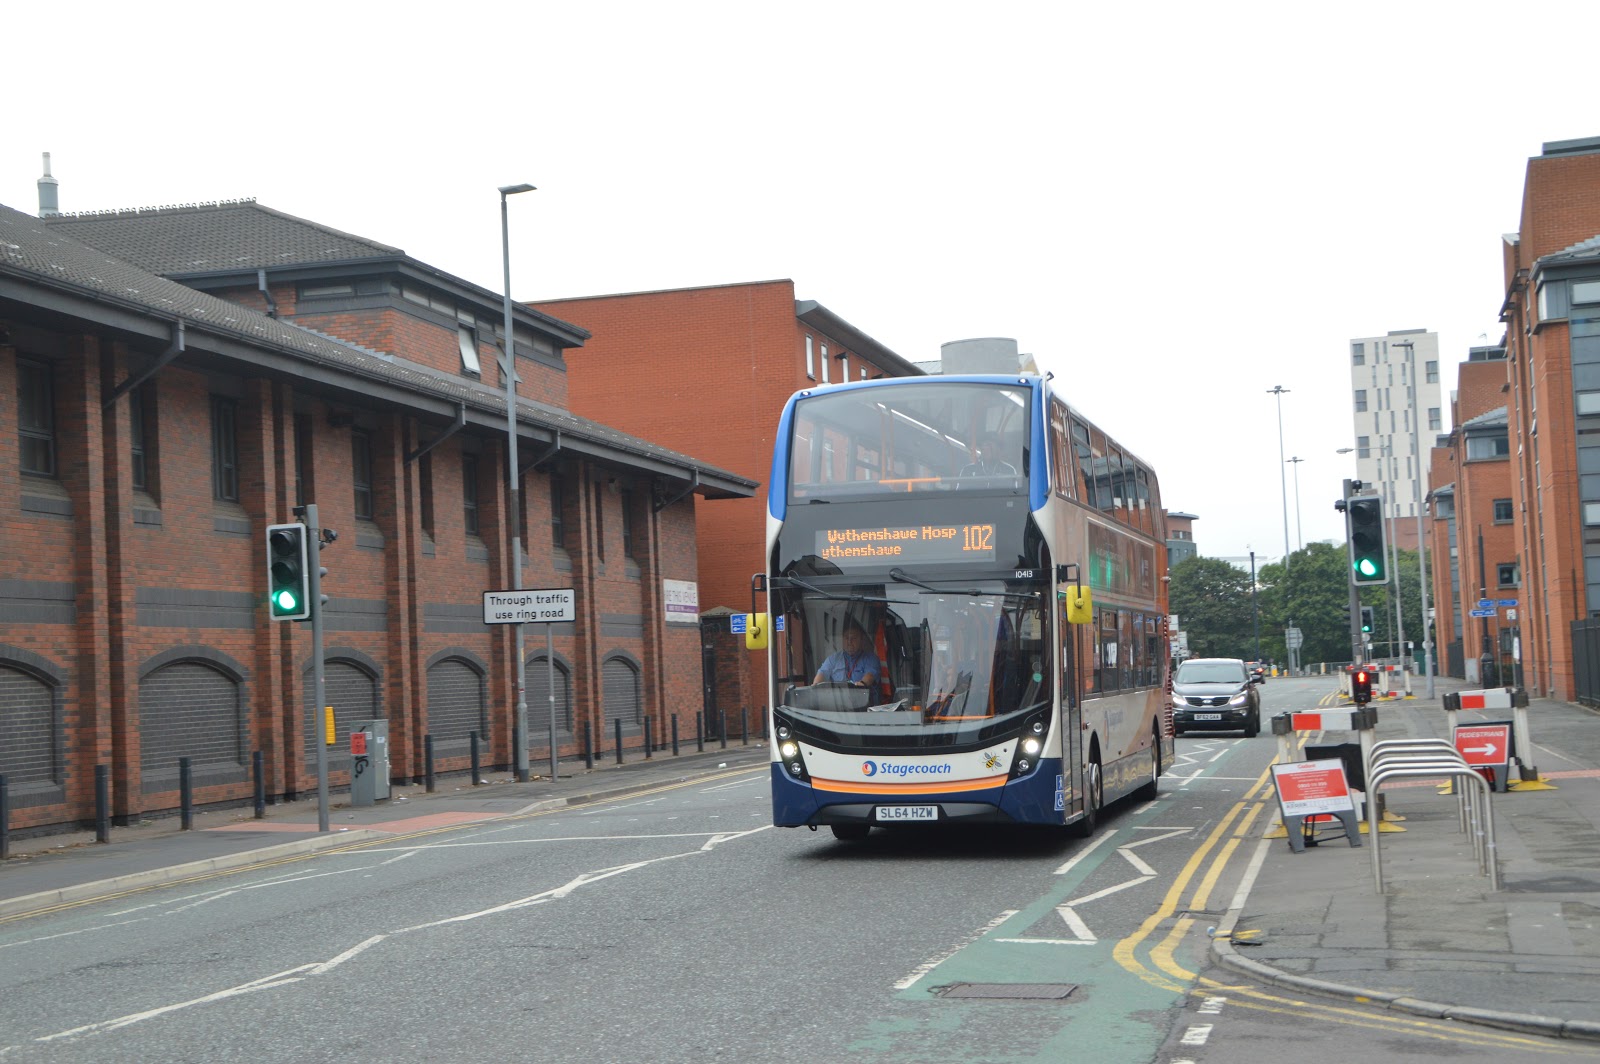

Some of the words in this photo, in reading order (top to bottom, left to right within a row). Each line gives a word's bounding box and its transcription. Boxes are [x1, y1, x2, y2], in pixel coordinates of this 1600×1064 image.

[827, 527, 917, 544] Wythenshawe
[922, 526, 957, 540] Hosp
[962, 524, 993, 551] 102
[822, 543, 902, 560] ythenshawe
[1015, 570, 1033, 579] 10413
[489, 595, 532, 606] Through
[536, 594, 569, 604] traffic
[495, 611, 513, 619] use
[516, 609, 537, 620] ring
[541, 608, 564, 618] road
[881, 763, 951, 777] Stagecoach
[880, 807, 909, 818] SL64
[911, 807, 933, 818] HZW
